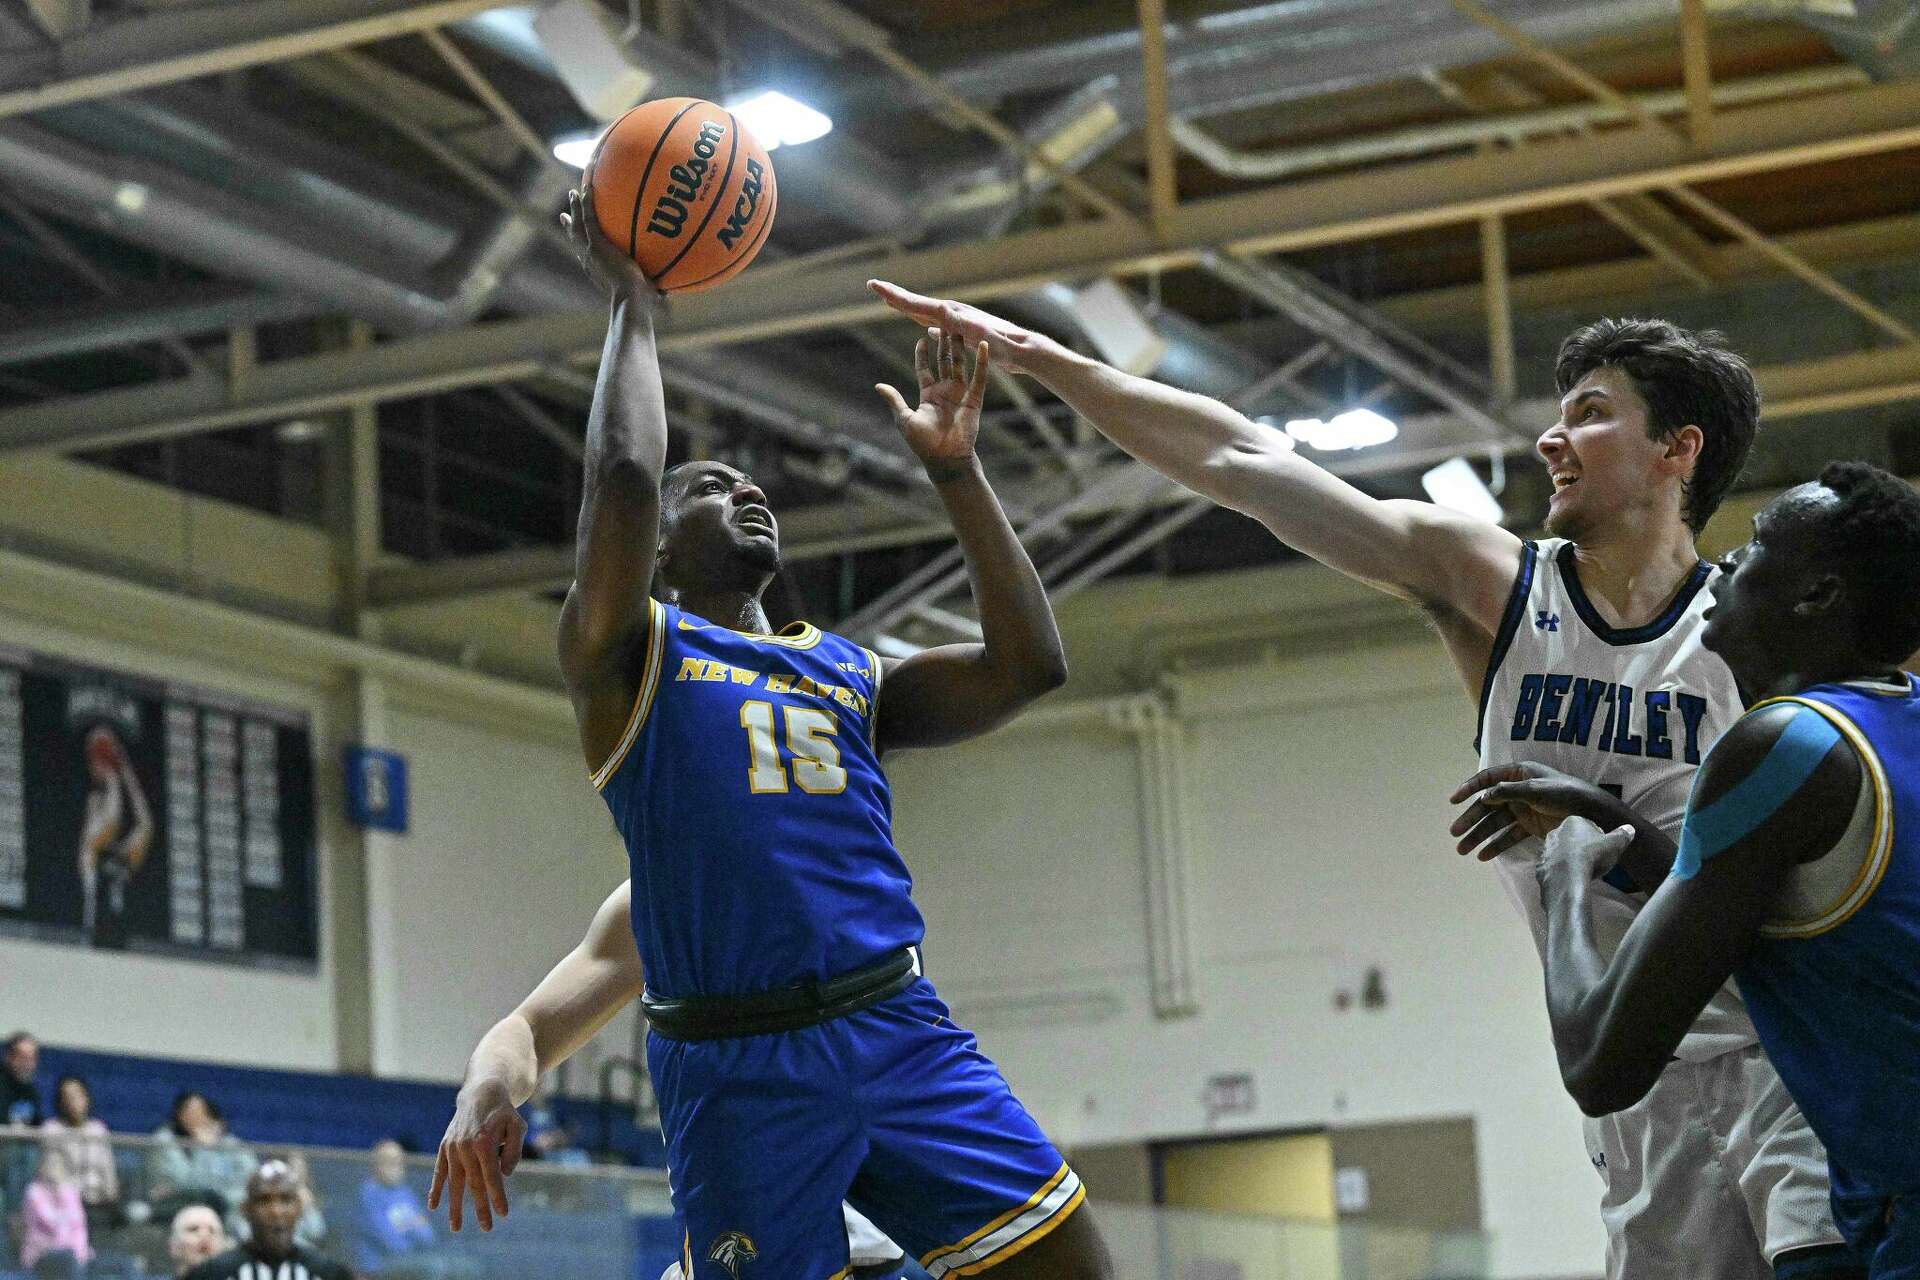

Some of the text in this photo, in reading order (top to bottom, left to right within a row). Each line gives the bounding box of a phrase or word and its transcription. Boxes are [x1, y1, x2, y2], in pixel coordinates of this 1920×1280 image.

[646, 120, 726, 238] Wilson
[716, 157, 764, 251] NCAA
[675, 657, 760, 686] NEW
[739, 700, 847, 794] 15
[1511, 673, 1707, 766] BENTLEY
